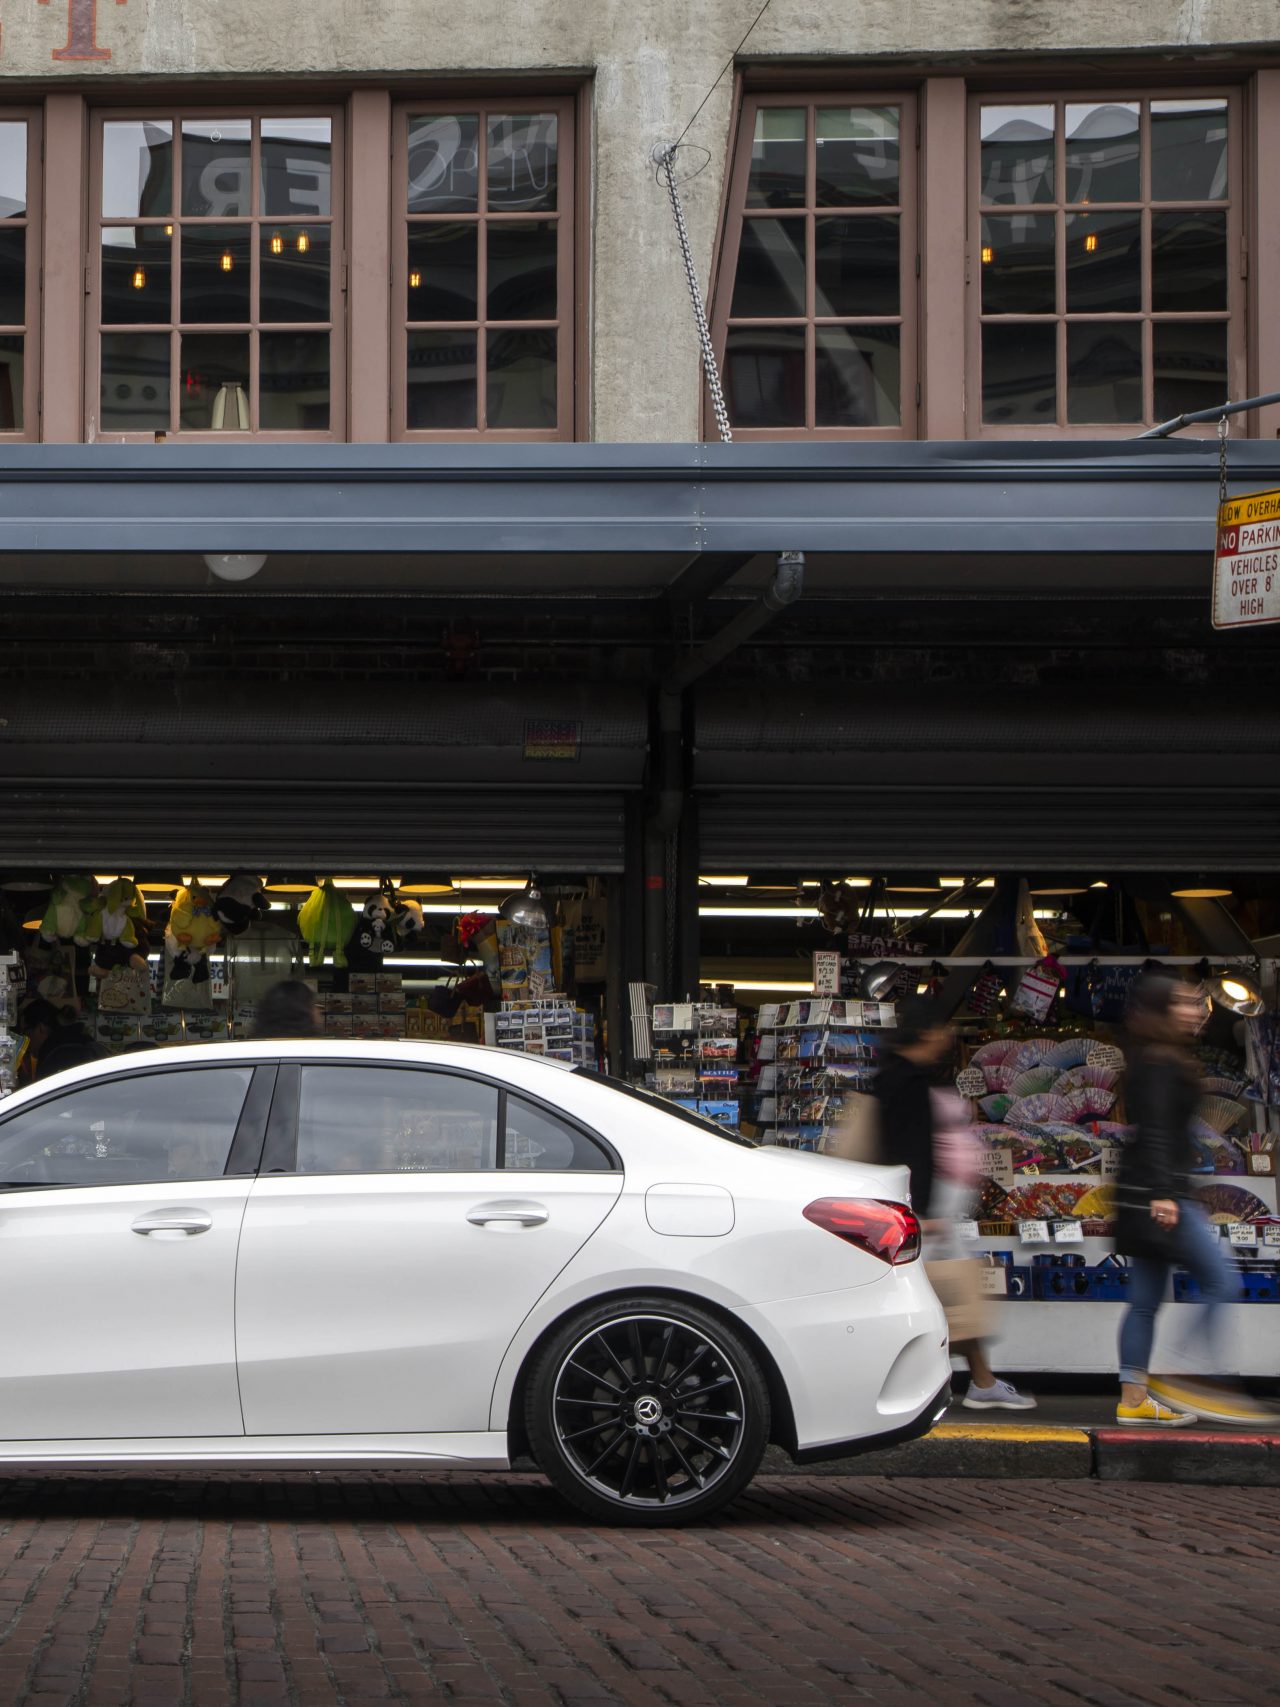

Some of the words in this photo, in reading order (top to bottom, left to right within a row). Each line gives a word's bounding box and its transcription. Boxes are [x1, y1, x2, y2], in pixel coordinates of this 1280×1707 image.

[407, 147, 550, 193] OPEN
[1222, 505, 1241, 522] LOW
[1221, 532, 1236, 550] NO
[1230, 555, 1278, 577] VEHICLES
[1232, 578, 1258, 597] OVER
[1240, 597, 1264, 616] HIGH
[848, 933, 926, 954] SEATTLE
